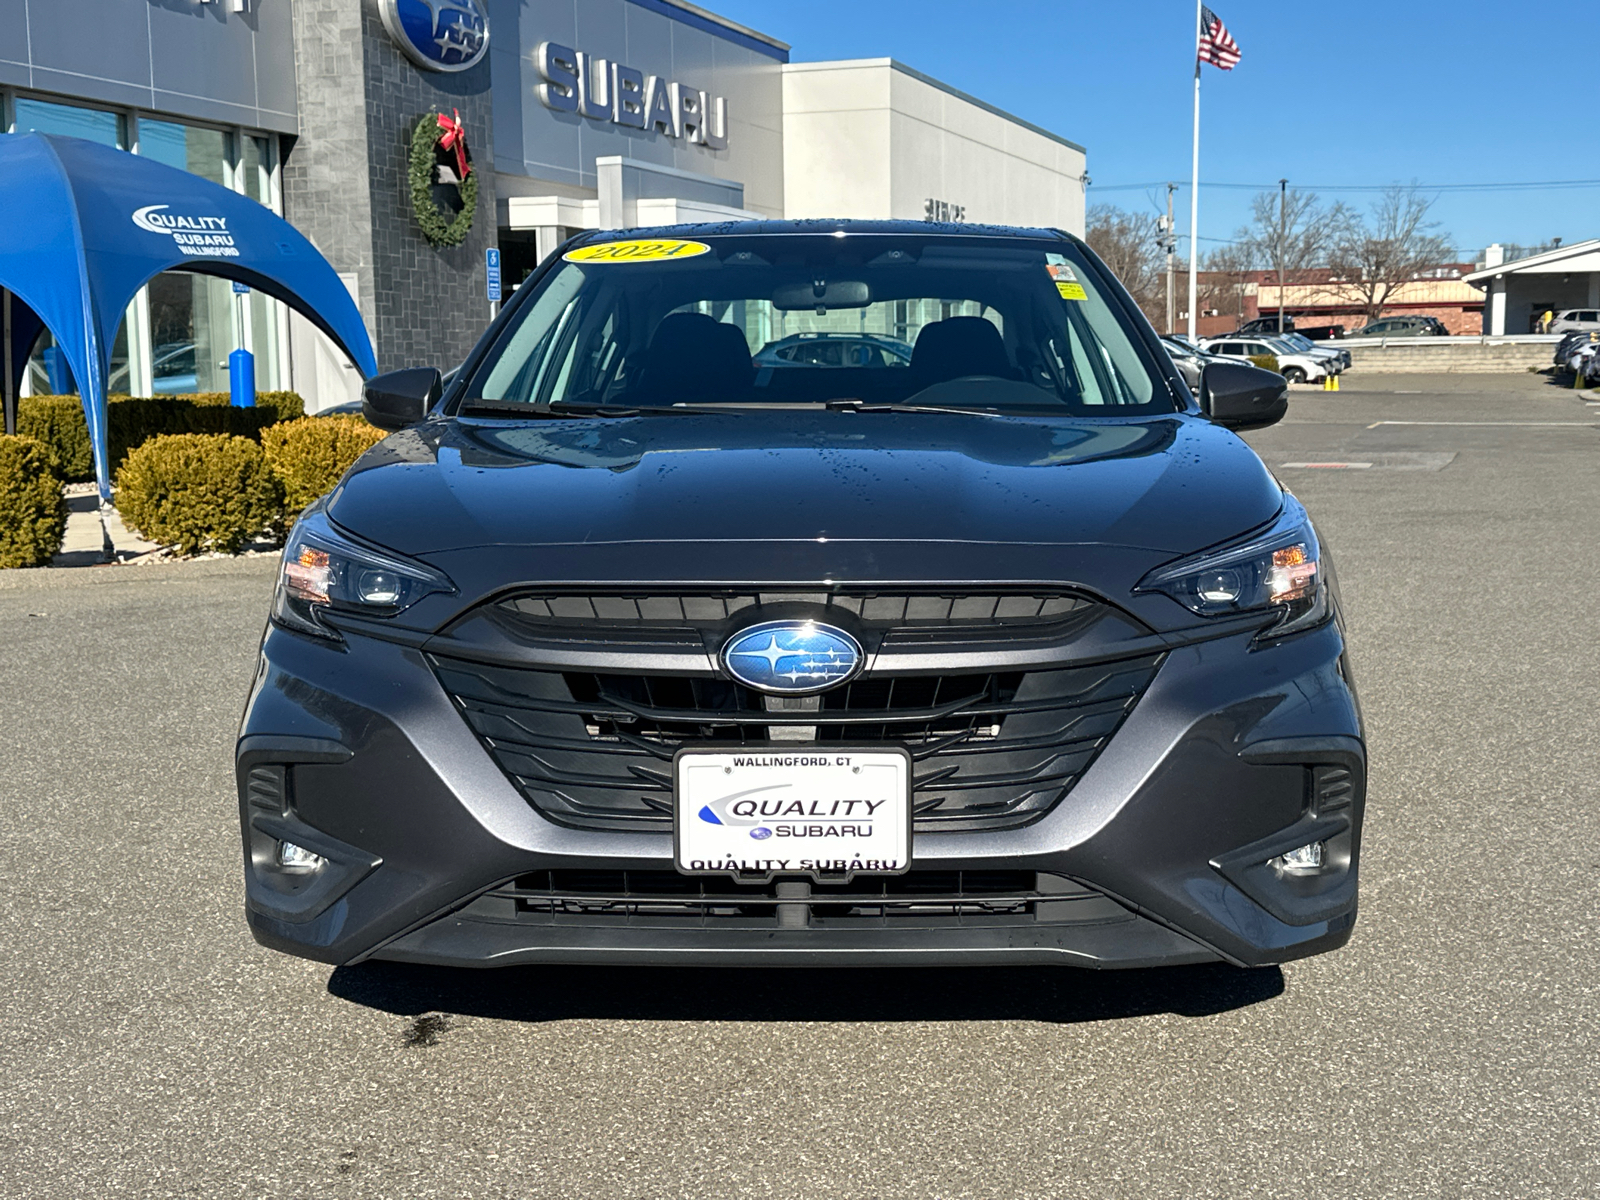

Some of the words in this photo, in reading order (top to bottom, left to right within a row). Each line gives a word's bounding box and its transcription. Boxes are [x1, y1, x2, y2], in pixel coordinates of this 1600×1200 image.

[538, 41, 728, 150] SUBARU
[148, 213, 226, 229] QUALITY
[173, 233, 235, 246] SUBARU
[178, 245, 240, 256] WALLINGFORD
[584, 243, 688, 259] 2024
[733, 757, 832, 767] WALLINGFORD,
[836, 757, 852, 766] CT
[732, 799, 887, 817] QUALITY
[775, 825, 873, 838] SUBARU
[690, 859, 790, 870] QUALITY
[799, 859, 897, 870] SUBARU
